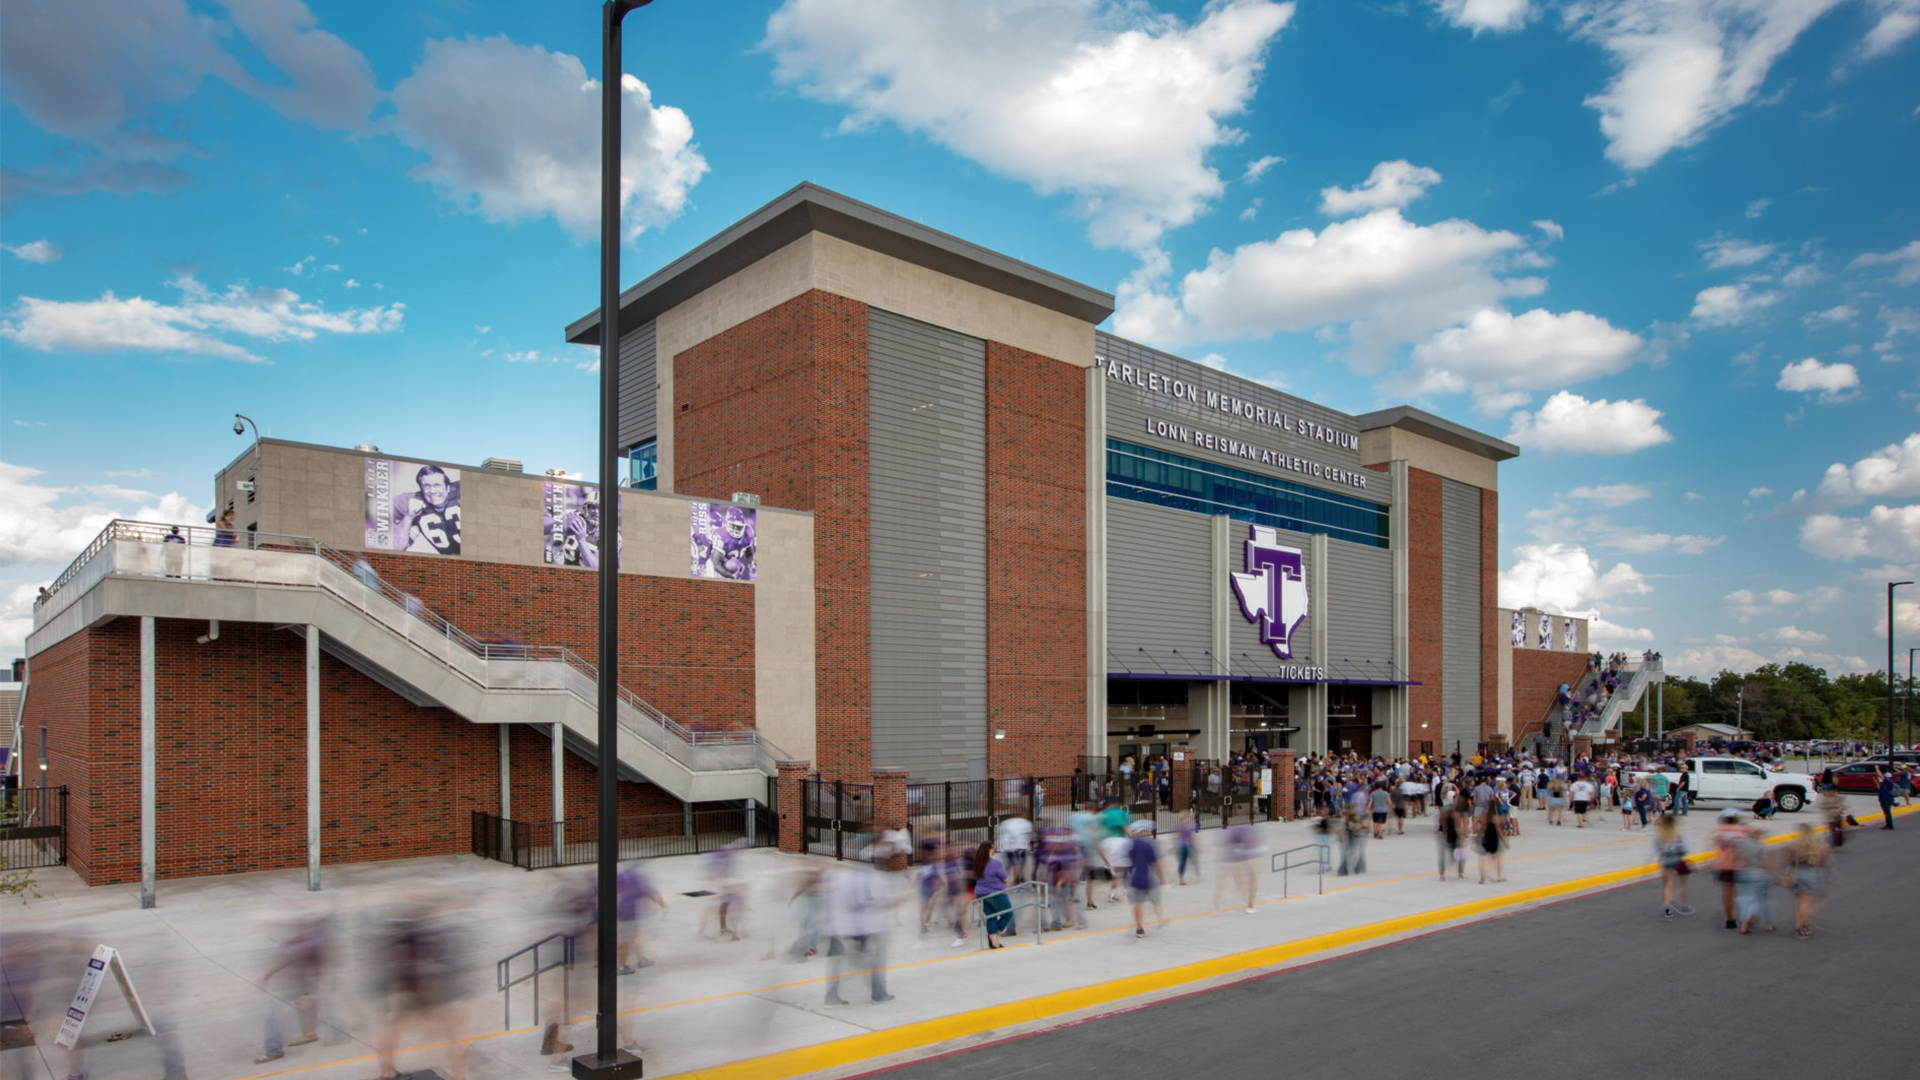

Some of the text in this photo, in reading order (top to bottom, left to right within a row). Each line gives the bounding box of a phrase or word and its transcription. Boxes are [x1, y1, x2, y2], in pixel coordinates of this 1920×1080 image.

[1095, 355, 1358, 451] TARLETON MEMORIAL STADIUM
[1147, 418, 1366, 488] LONN REISMAN ATHLETIC CENTER
[376, 461, 390, 532] WINKLER
[553, 484, 564, 541] DEARTH
[698, 502, 707, 535] ROSS
[1248, 543, 1303, 642] T
[1280, 665, 1324, 681] TICKETS
